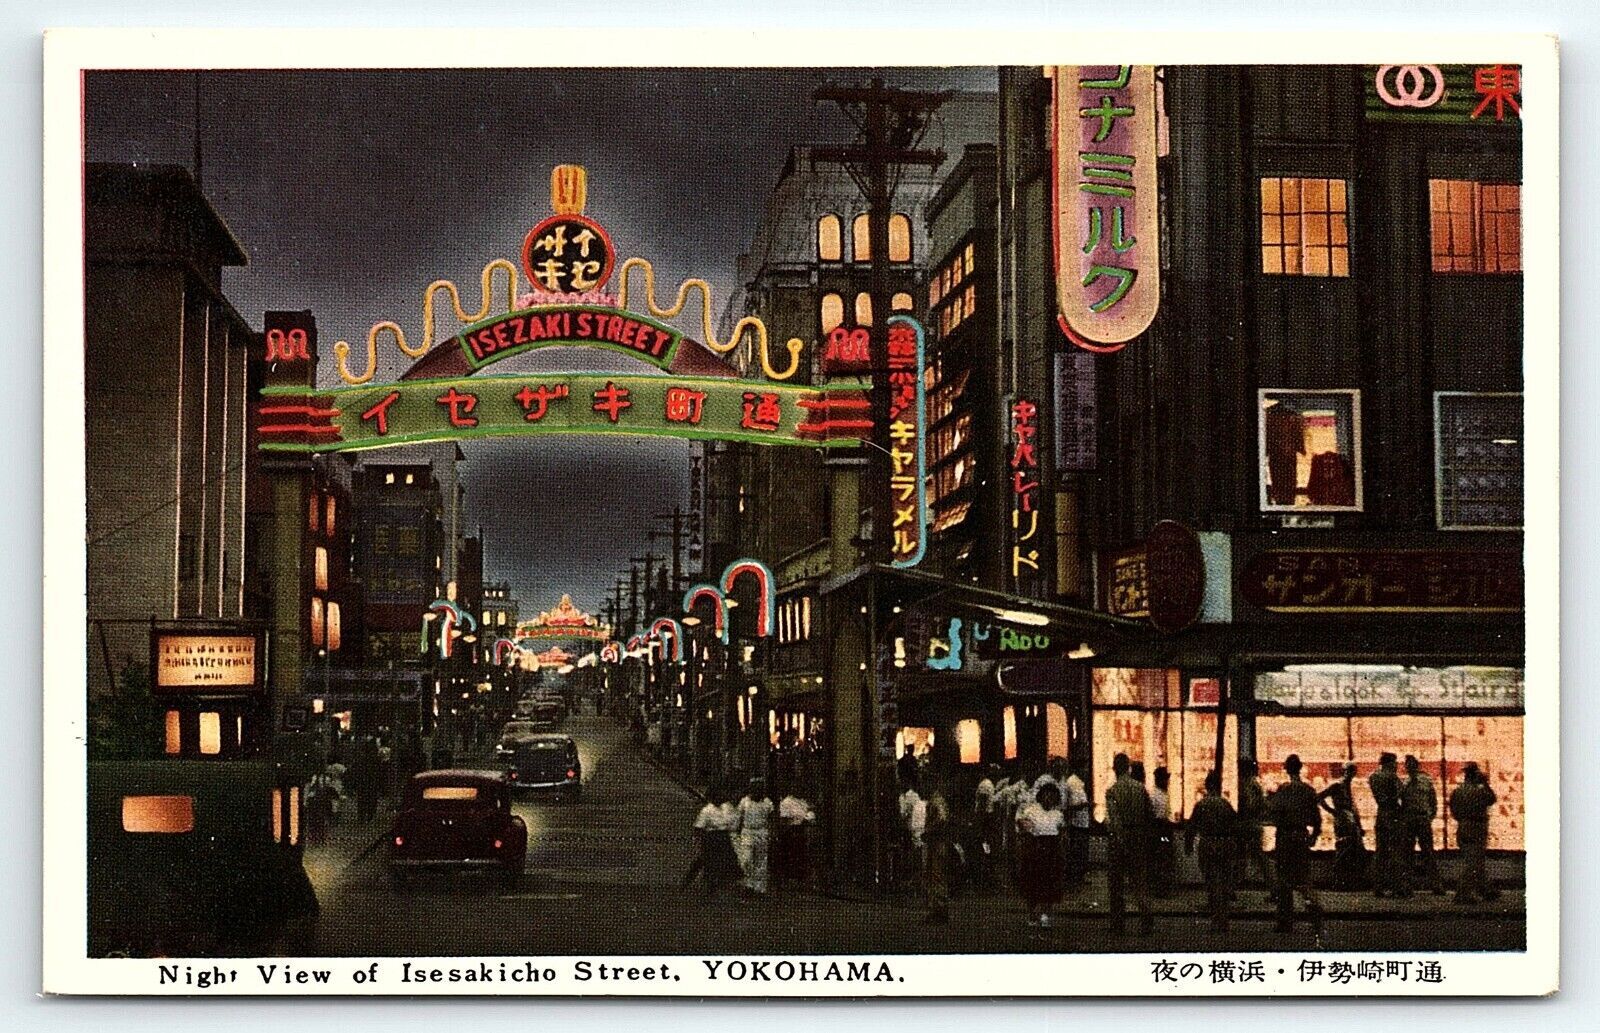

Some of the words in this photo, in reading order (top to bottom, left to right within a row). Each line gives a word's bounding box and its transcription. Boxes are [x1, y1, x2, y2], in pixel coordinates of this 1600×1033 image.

[468, 312, 571, 358] ISEZAKI
[576, 311, 671, 356] STREET
[361, 381, 783, 434] イセザキ町通
